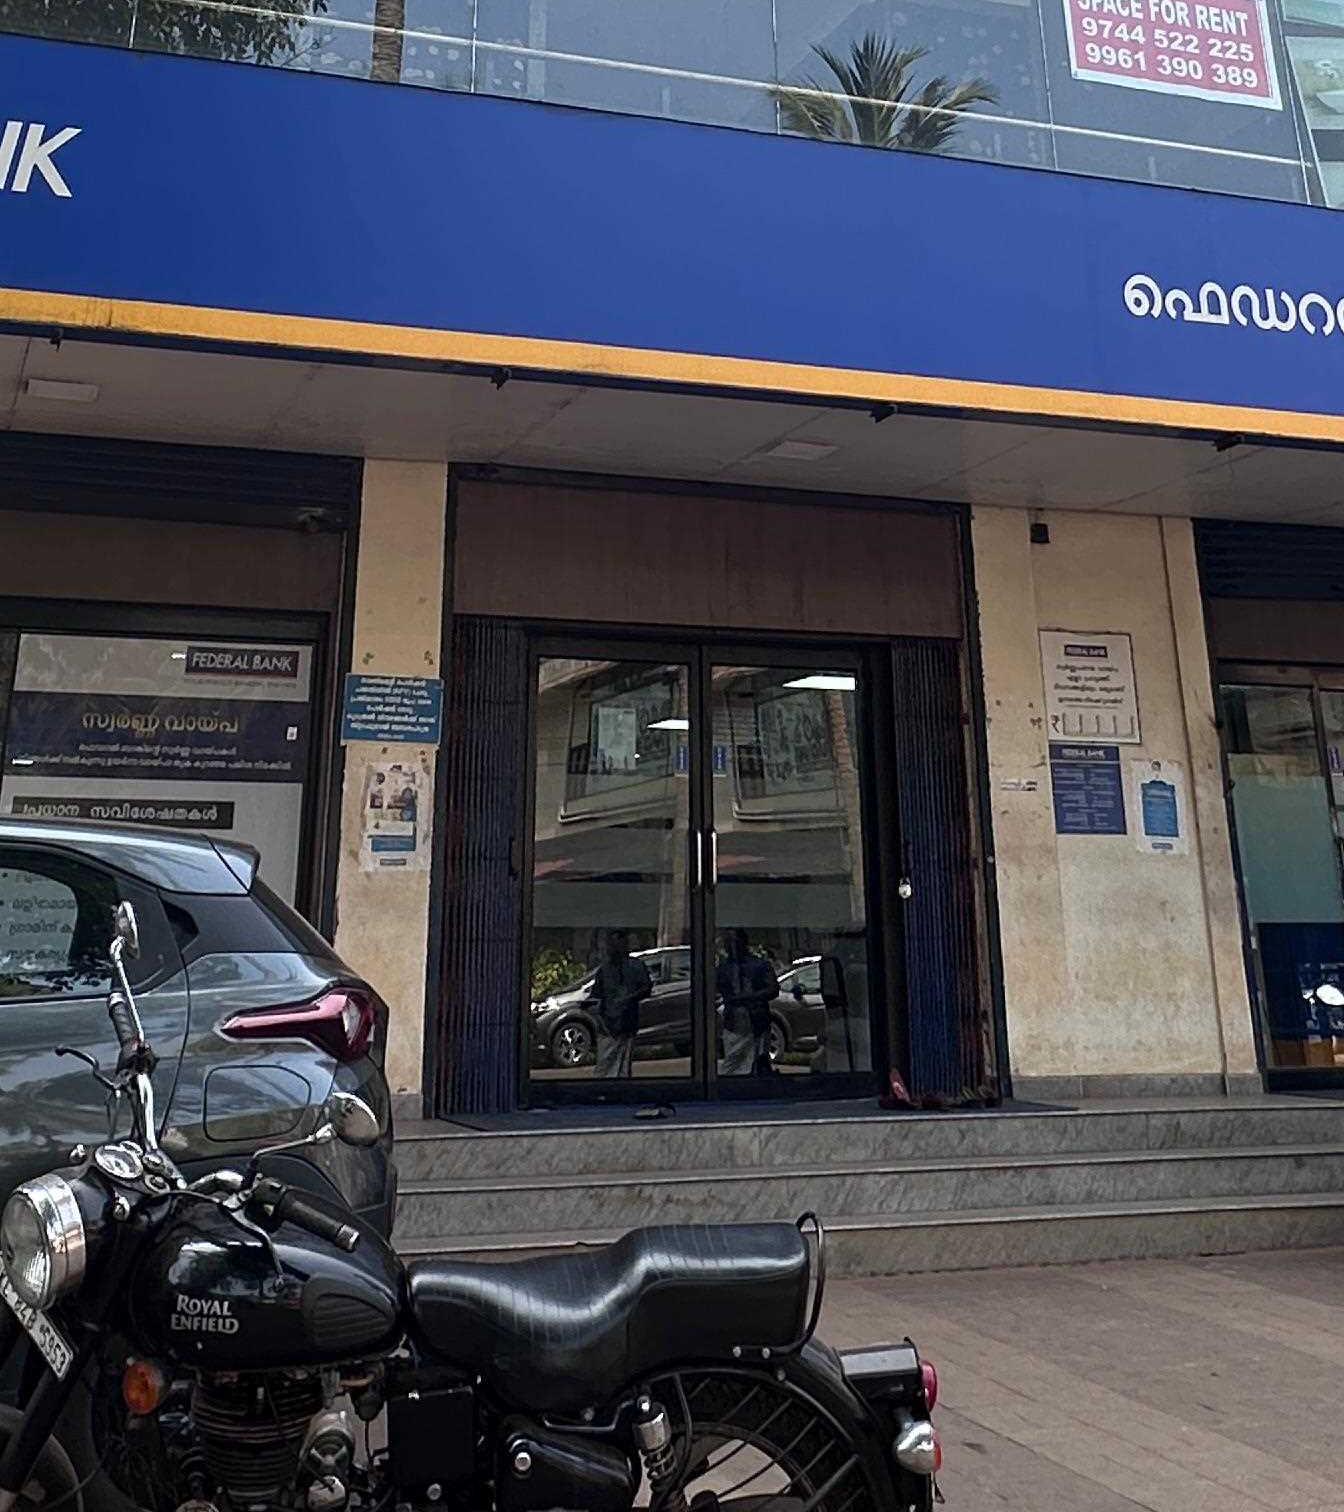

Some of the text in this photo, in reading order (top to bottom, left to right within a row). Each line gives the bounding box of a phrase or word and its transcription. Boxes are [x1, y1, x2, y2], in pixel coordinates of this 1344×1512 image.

[1195, 3, 1248, 37] RENT
[1081, 17, 1254, 62] 9744 522 225
[1085, 43, 1258, 88] 9961 390 389
[191, 650, 295, 673] FEDERAL BANK
[176, 1293, 233, 1317] ROYAL
[170, 1313, 239, 1334] ENFIELD
